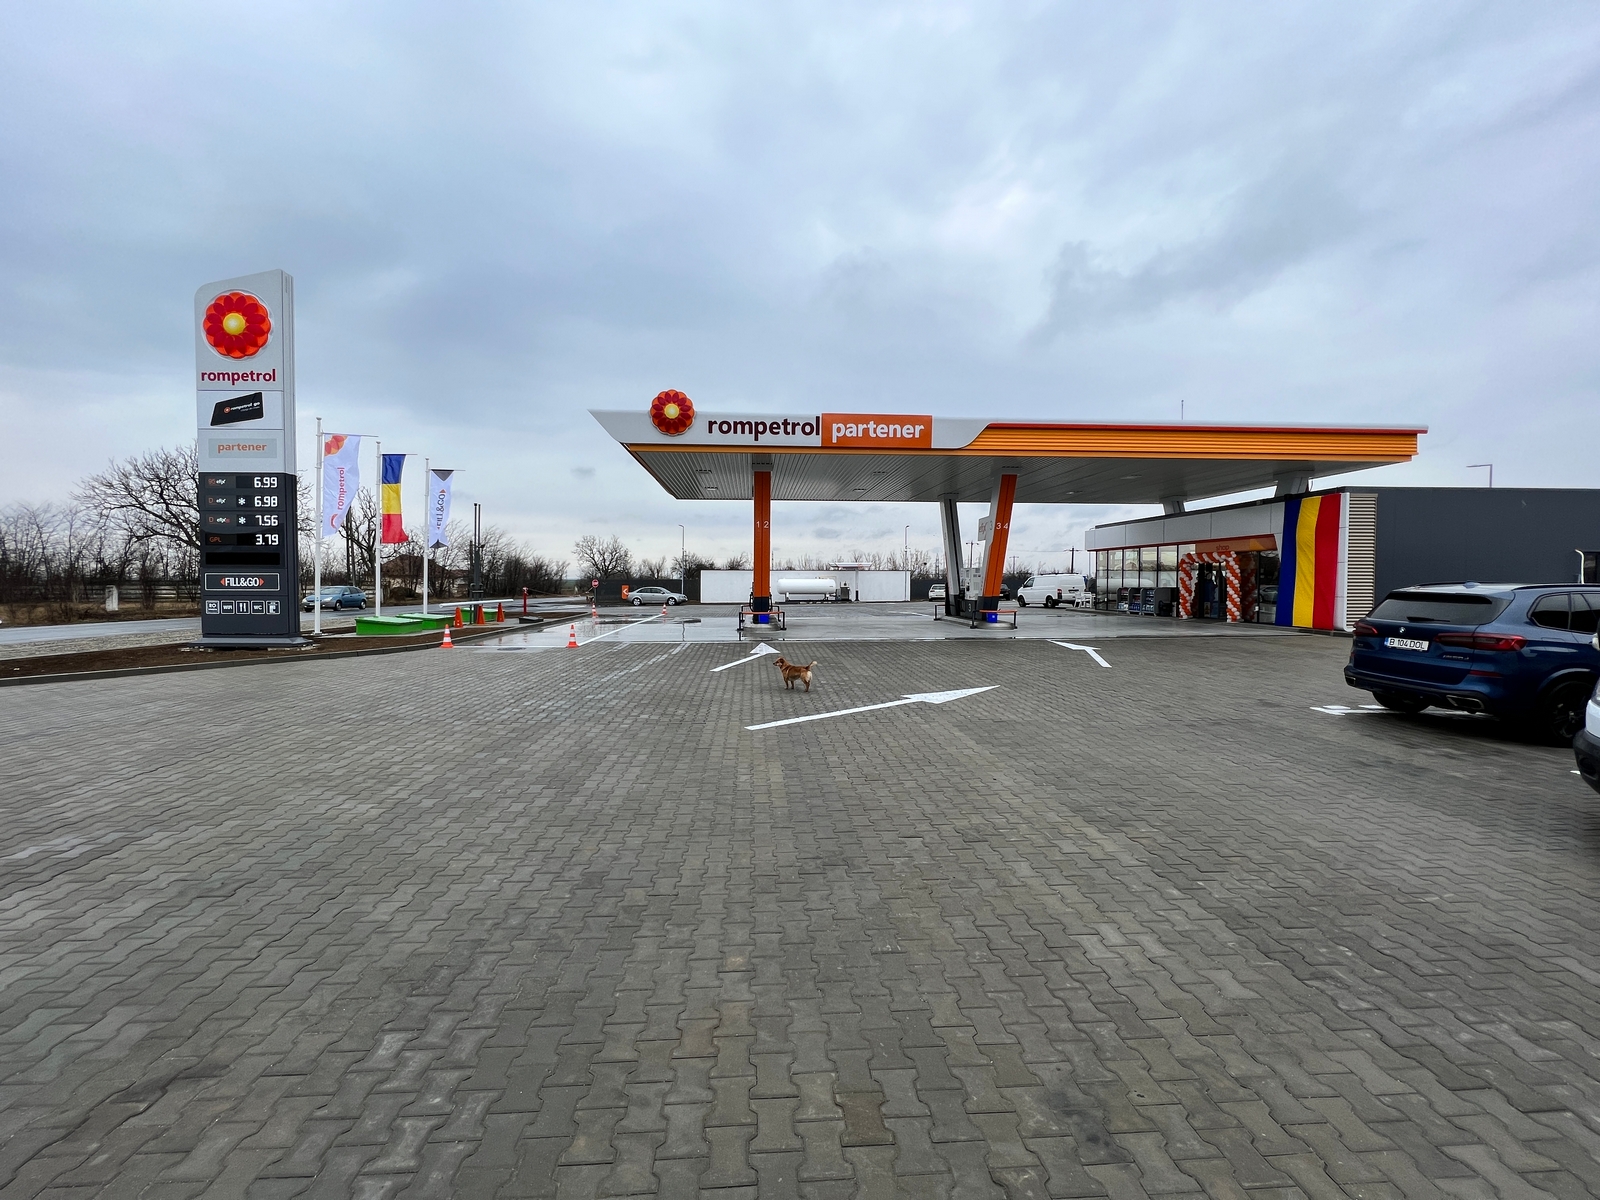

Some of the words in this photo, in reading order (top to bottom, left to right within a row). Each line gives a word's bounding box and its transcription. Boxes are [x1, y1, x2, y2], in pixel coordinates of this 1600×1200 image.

[201, 369, 276, 385] rompetrol
[707, 416, 820, 441] rompetrol
[832, 420, 925, 443] partener
[217, 443, 267, 453] partener
[254, 476, 278, 488] 6.99
[336, 467, 347, 511] rompetrol
[254, 495, 278, 507] 6.98
[435, 493, 446, 527] FILL&GO
[255, 514, 279, 526] 7.56
[763, 520, 770, 529] 2
[996, 522, 1002, 530] 3
[1003, 522, 1009, 530] 4
[255, 533, 279, 545] 3.79
[225, 577, 260, 587] FILL&GO
[1397, 639, 1408, 647] 104
[1409, 640, 1425, 649] DOL
